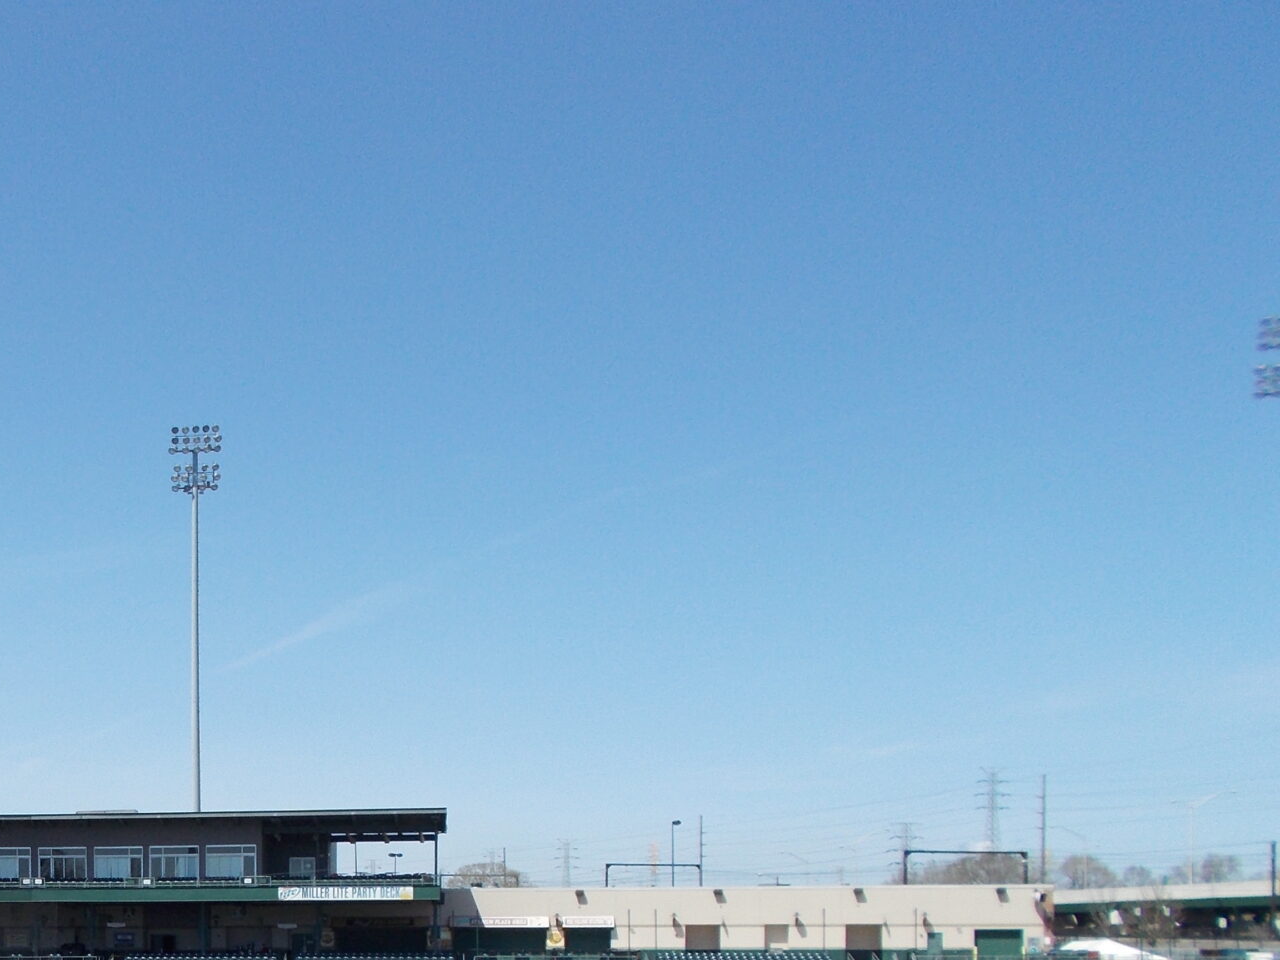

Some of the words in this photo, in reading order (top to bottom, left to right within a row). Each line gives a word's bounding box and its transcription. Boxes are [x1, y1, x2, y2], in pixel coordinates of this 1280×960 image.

[301, 887, 330, 899] MILLER
[333, 887, 349, 899] LITE
[352, 887, 377, 899] PARTY
[380, 887, 401, 899] DECK
